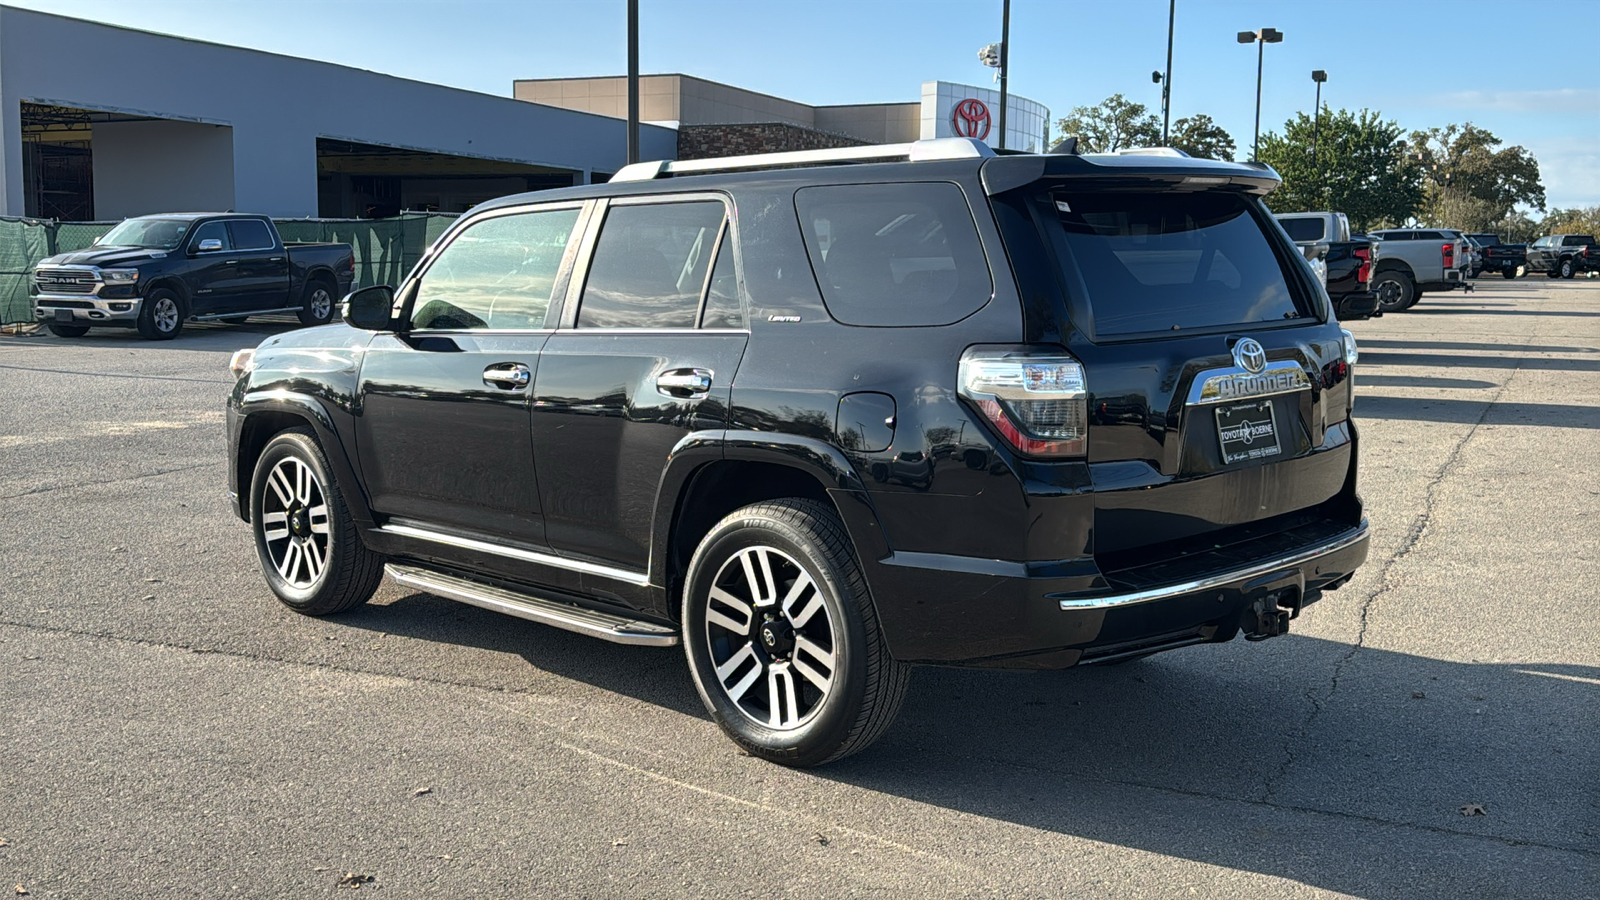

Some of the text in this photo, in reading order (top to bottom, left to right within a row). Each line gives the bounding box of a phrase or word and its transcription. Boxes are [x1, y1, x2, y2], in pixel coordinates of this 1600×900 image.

[1221, 424, 1273, 441] TOYOTA BOERNE
[743, 518, 774, 530] TIGER
